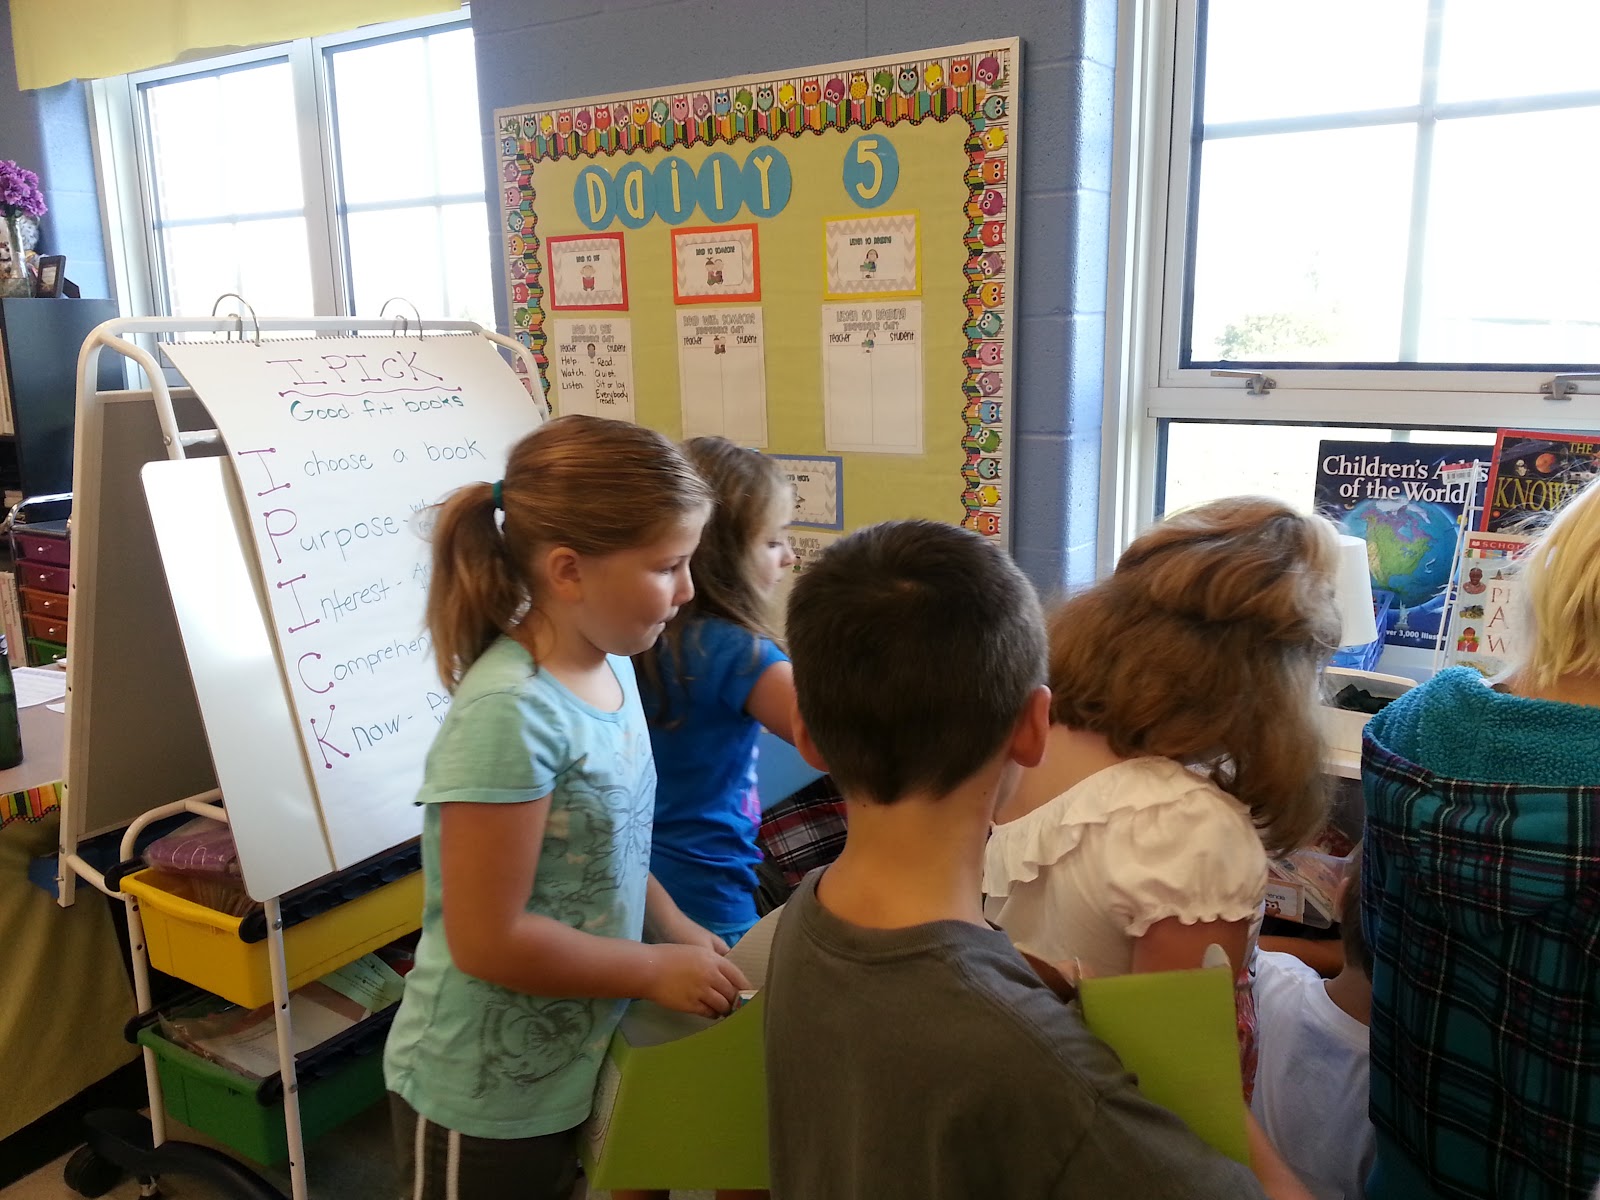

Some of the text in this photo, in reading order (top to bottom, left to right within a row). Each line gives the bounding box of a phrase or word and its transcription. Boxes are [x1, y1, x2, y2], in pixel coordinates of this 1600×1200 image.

[856, 140, 883, 199] 5
[363, 399, 393, 418] fit
[402, 394, 464, 413] books
[1569, 442, 1593, 454] THE
[238, 437, 487, 497] I choose a book
[1322, 454, 1429, 480] Children's
[1339, 477, 1466, 504] of the World
[1399, 630, 1420, 638] 3,000
[297, 635, 430, 694] Comprehen
